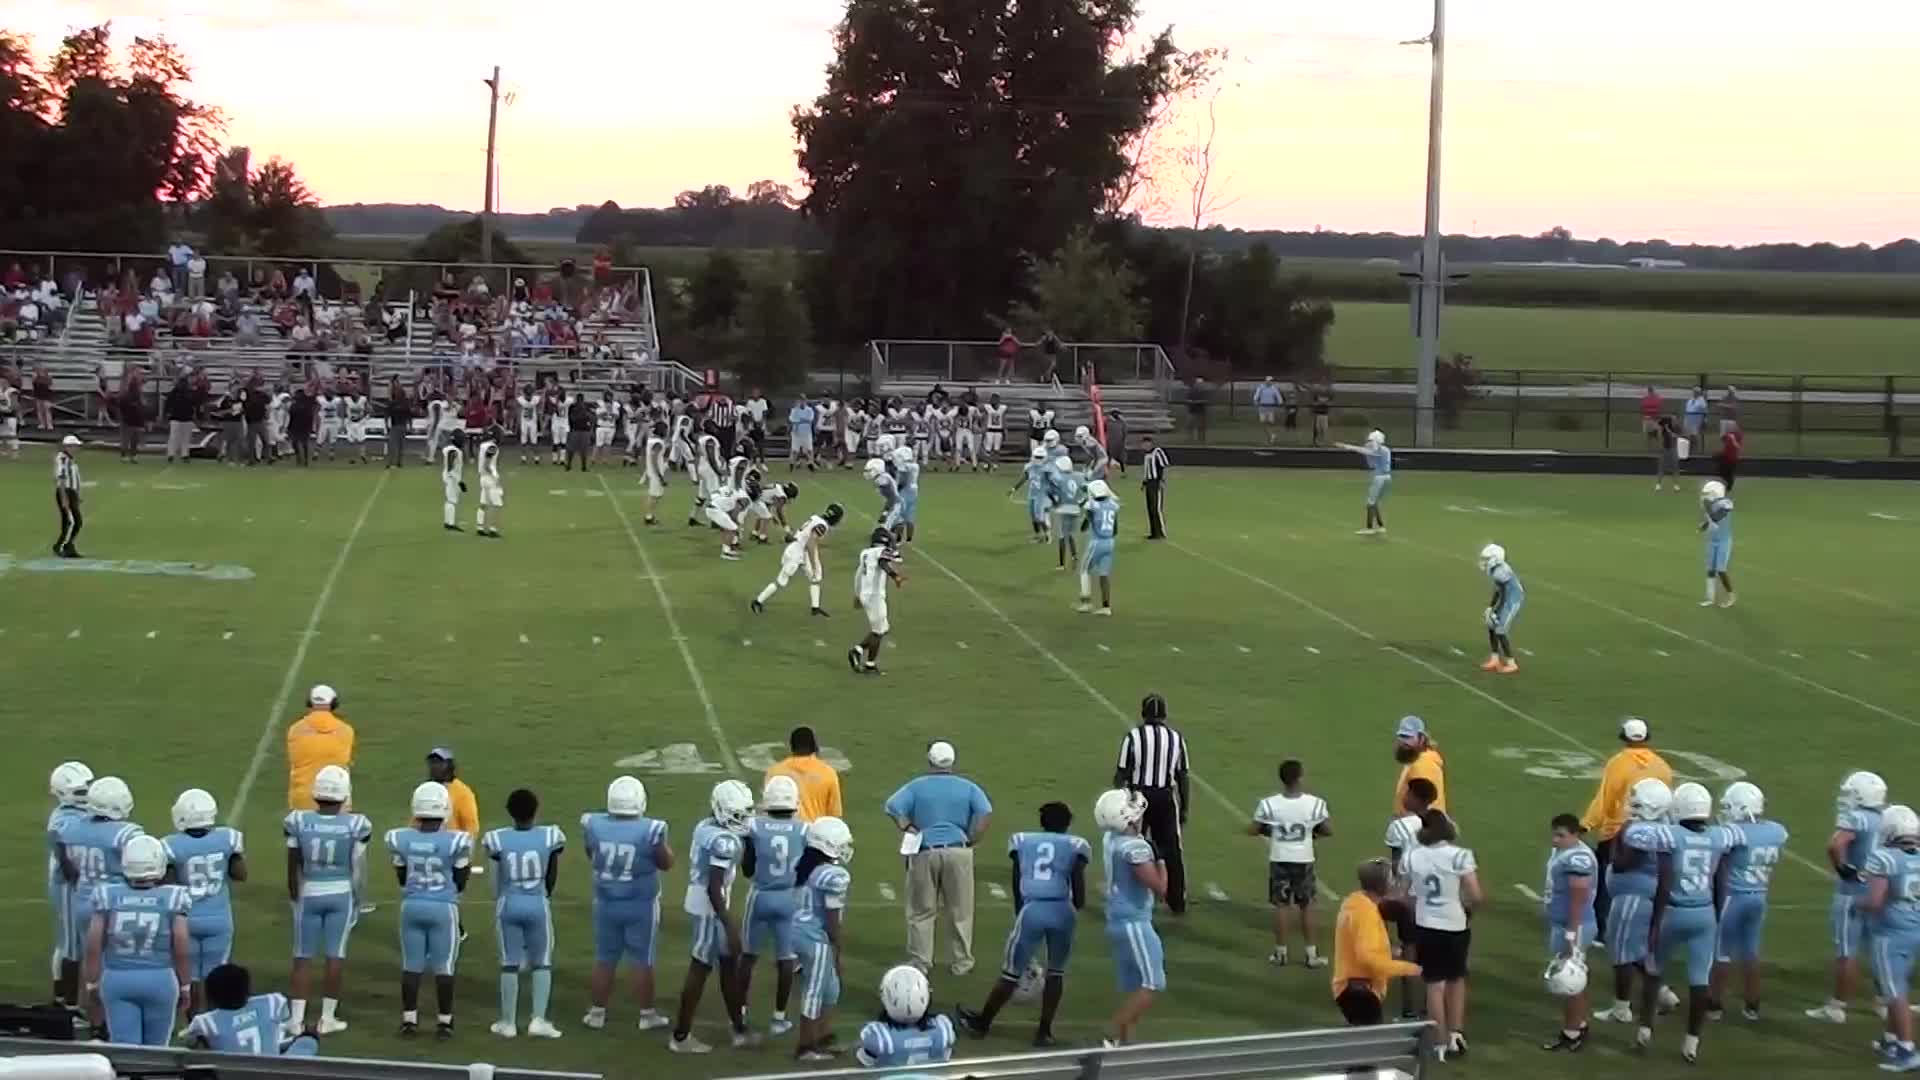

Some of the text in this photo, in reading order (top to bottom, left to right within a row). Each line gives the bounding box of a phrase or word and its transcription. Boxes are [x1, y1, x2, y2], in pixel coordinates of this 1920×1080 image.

[310, 837, 338, 871] 11
[507, 850, 542, 889] 10
[599, 841, 636, 881] 77
[769, 835, 790, 877] 3
[1033, 842, 1055, 881] 2
[1423, 874, 1442, 906] 2
[113, 911, 160, 955] 57
[236, 1026, 262, 1056] 7
